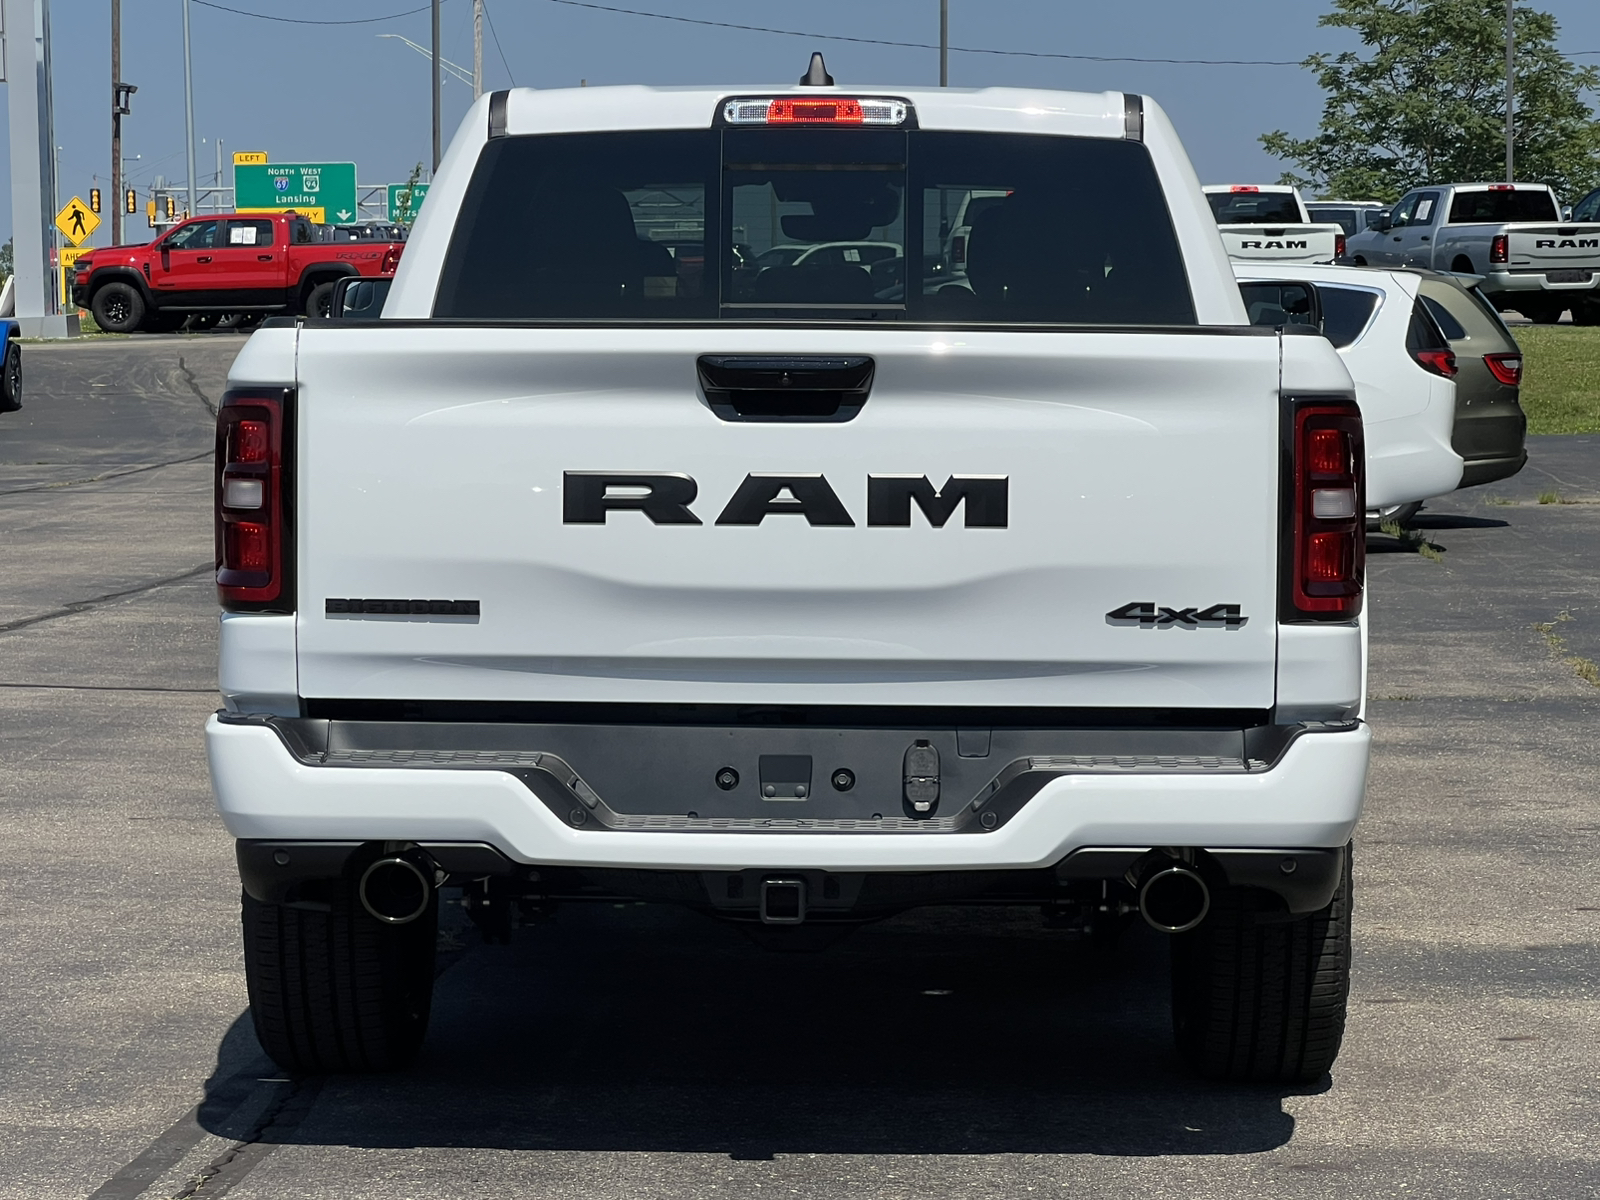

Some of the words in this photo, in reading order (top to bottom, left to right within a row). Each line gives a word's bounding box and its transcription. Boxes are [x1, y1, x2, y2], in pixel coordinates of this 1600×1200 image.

[300, 167, 322, 175] WEST
[276, 180, 287, 189] 69
[306, 180, 317, 188] 94
[414, 189, 426, 197] EA
[275, 194, 316, 205] Lansing
[1241, 240, 1307, 249] RAM
[1535, 239, 1599, 249] RAM
[562, 470, 1009, 529] RAM
[1105, 602, 1249, 627] 4x4
